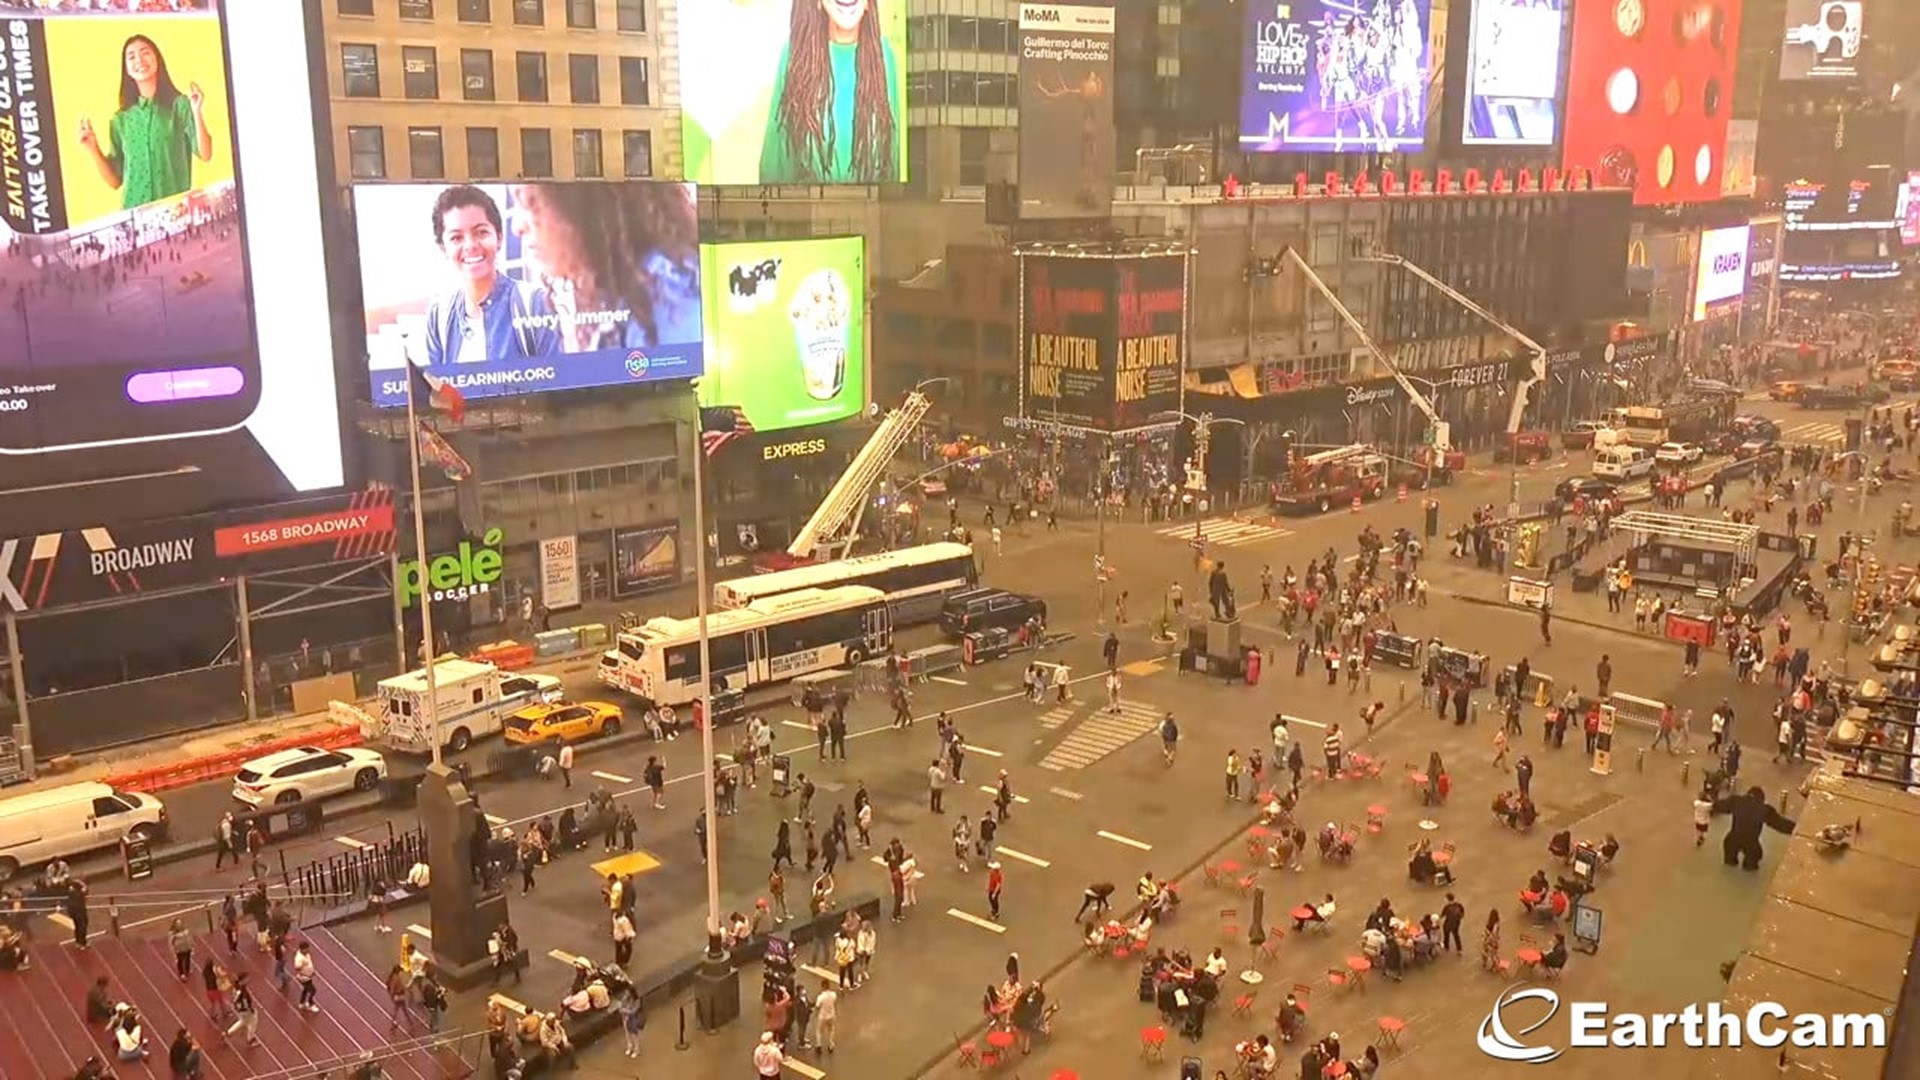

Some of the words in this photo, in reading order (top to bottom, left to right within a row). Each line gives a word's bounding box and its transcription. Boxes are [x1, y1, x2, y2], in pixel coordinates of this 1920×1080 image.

[1024, 9, 1060, 22] MoMA
[1024, 36, 1070, 49] Guillermo
[1071, 38, 1085, 49] del
[1257, 20, 1301, 46] LOVE
[9, 20, 35, 97] TIMES
[1024, 48, 1063, 62] Crafting
[1064, 49, 1108, 61] Pinocchio
[1256, 45, 1280, 64] HIP
[1280, 46, 1308, 66] HOP
[1256, 63, 1306, 76] ATLANTA
[19, 101, 43, 167] OVER
[27, 170, 51, 233] TAKE
[513, 313, 559, 331] every
[560, 309, 631, 326] ummer
[1029, 333, 1039, 364] A
[1040, 334, 1099, 371] BEAUTIFUL
[1115, 340, 1125, 371] A
[1126, 334, 1178, 369] BEAUTIFUL
[382, 366, 555, 395] SULEARNING.ORG
[1029, 365, 1062, 398] NOISE
[1115, 369, 1147, 403] NOISE
[1451, 365, 1495, 388] FOREVER
[1497, 362, 1509, 381] 21
[763, 439, 826, 460] EXPRESS
[242, 530, 279, 546] 1568
[281, 515, 369, 540] BROADWAY
[90, 538, 196, 577] BROADWAY
[545, 541, 569, 558] 1560
[397, 528, 503, 609] pelé
